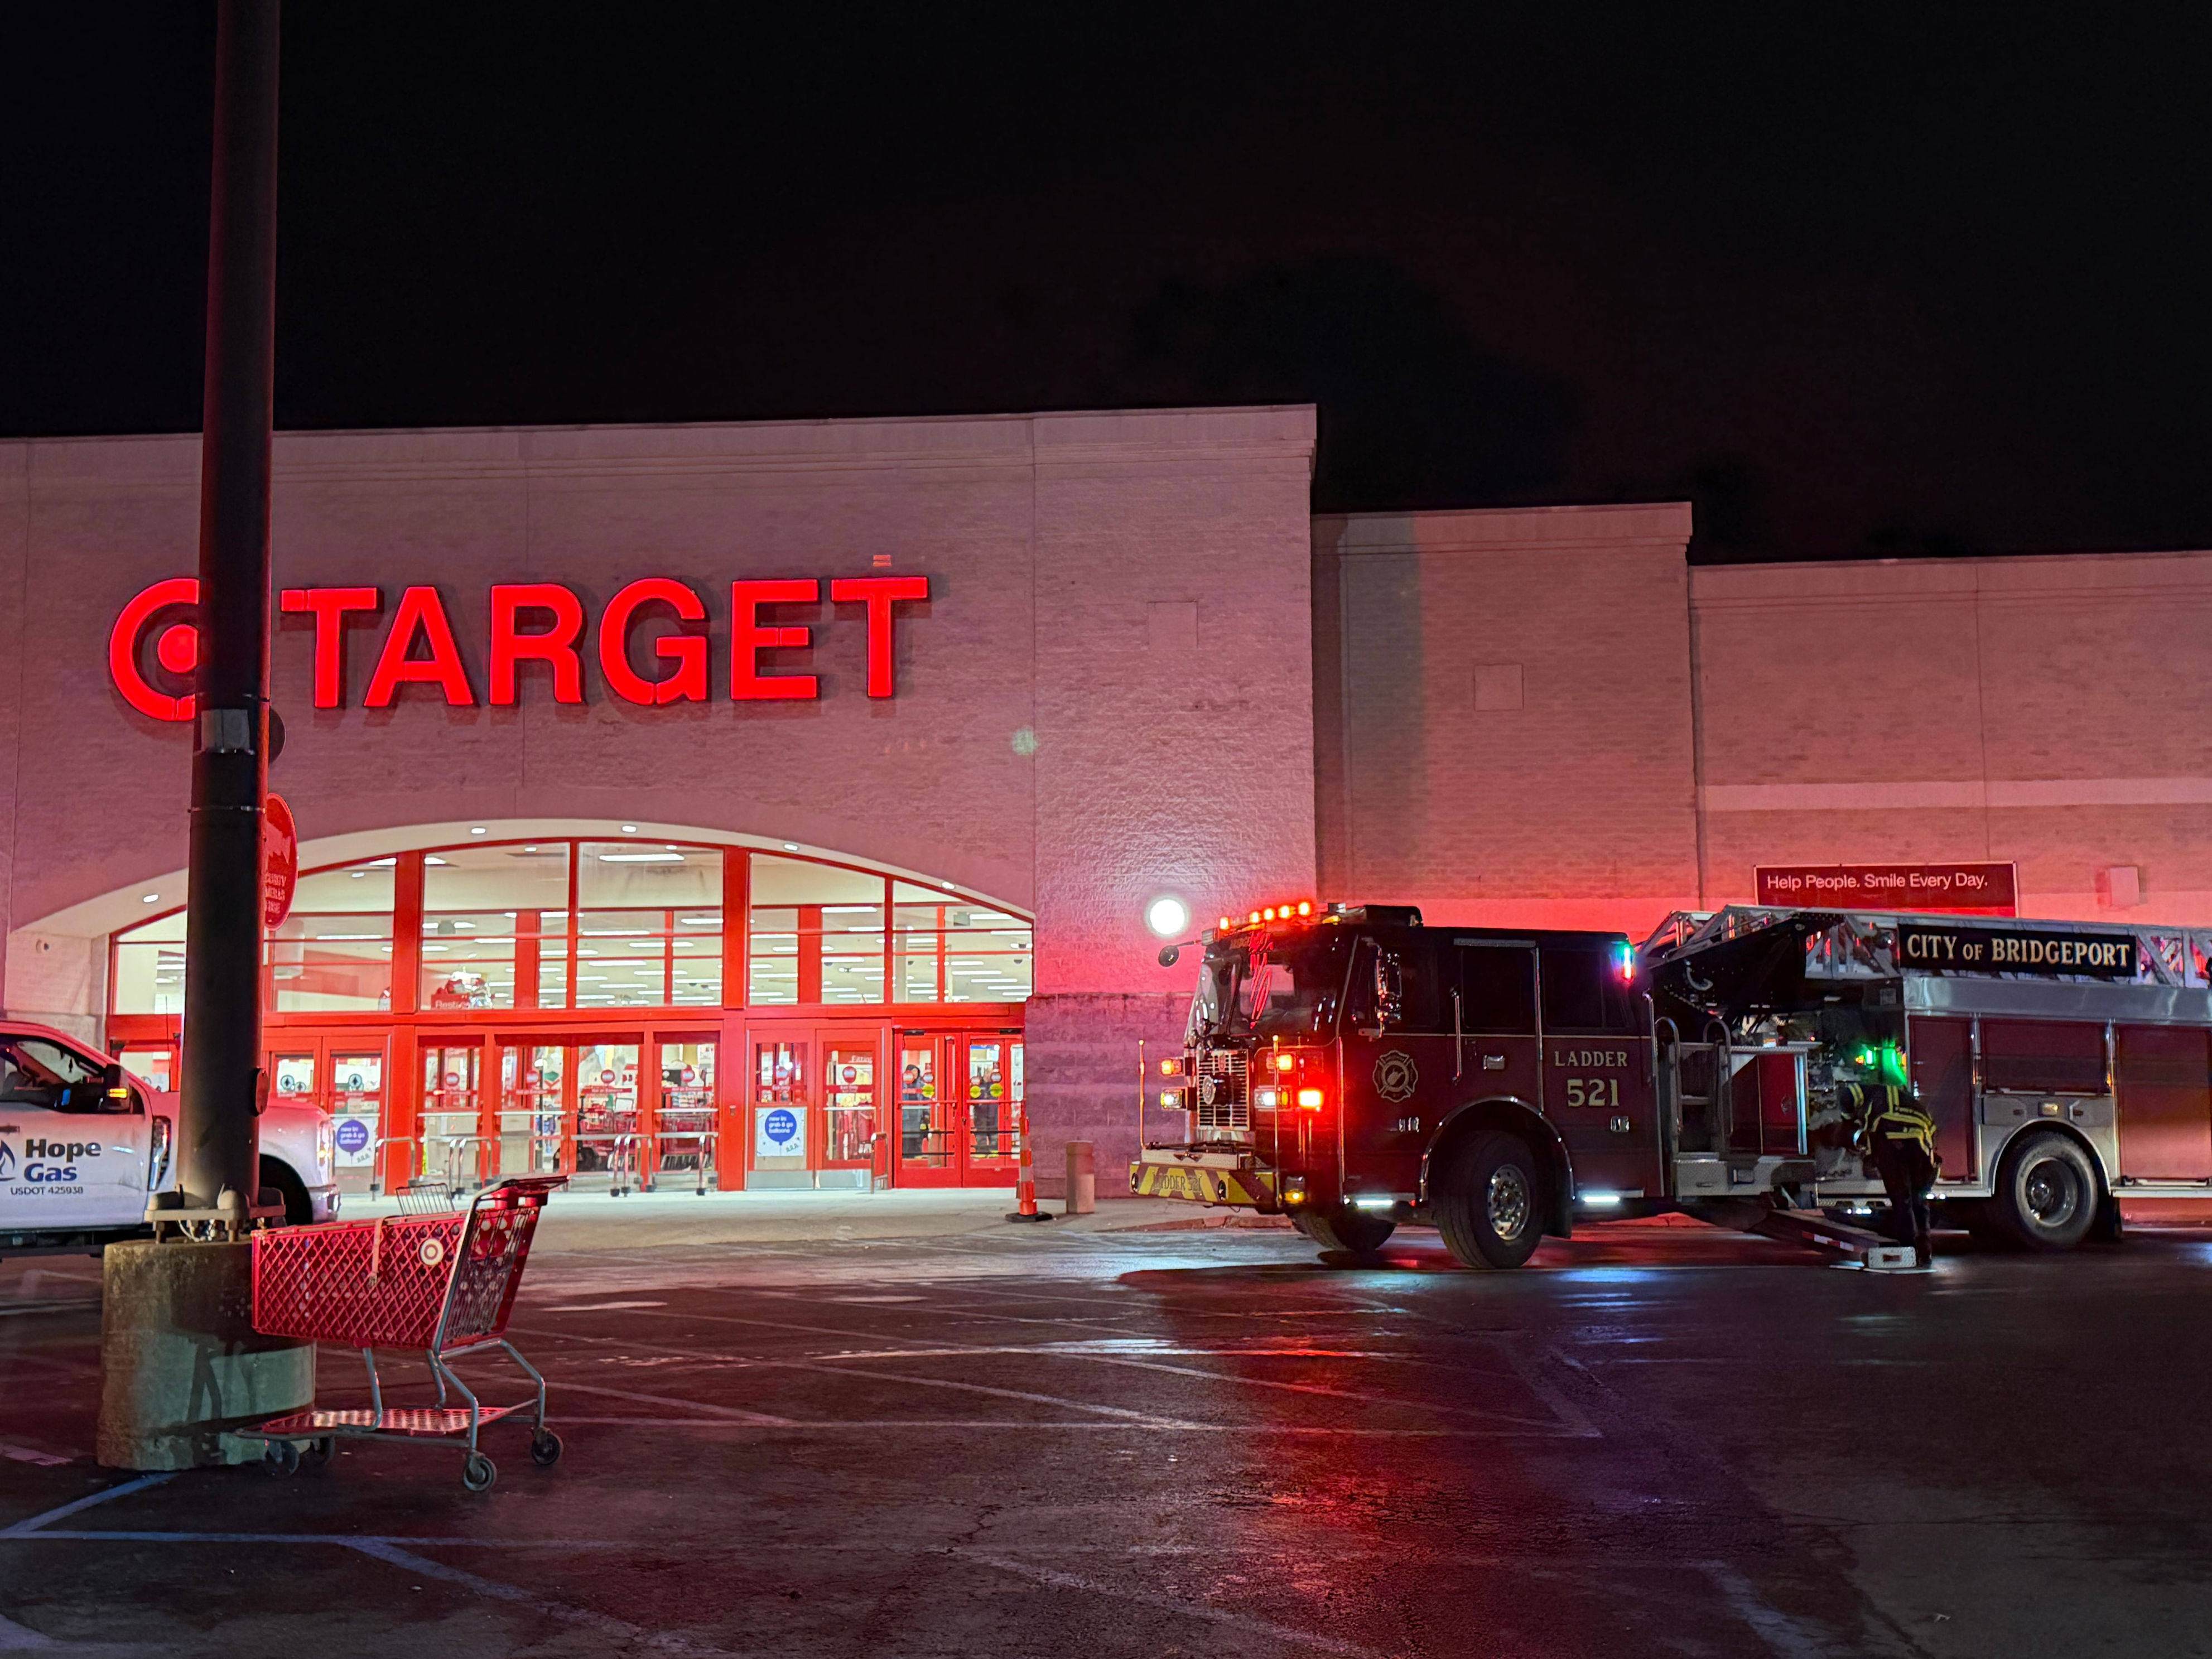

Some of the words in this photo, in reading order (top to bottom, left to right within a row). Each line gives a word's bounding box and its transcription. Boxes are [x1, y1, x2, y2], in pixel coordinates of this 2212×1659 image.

[281, 575, 929, 707] TARGET
[1767, 875, 1802, 892] Help
[1805, 874, 1861, 891] People.
[1864, 872, 1906, 888] Smile
[1910, 872, 1951, 890] Every
[1955, 872, 1988, 890] Day.
[1907, 934, 1957, 960] CITY
[1963, 943, 1983, 961] OF
[1991, 938, 2131, 967] BRIDGEPORT
[1554, 1050, 1628, 1067] LADDER
[1567, 1078, 1620, 1107] 521
[26, 1139, 102, 1163] Hope
[24, 1163, 77, 1183] Gas
[10, 1187, 46, 1195] USDOT
